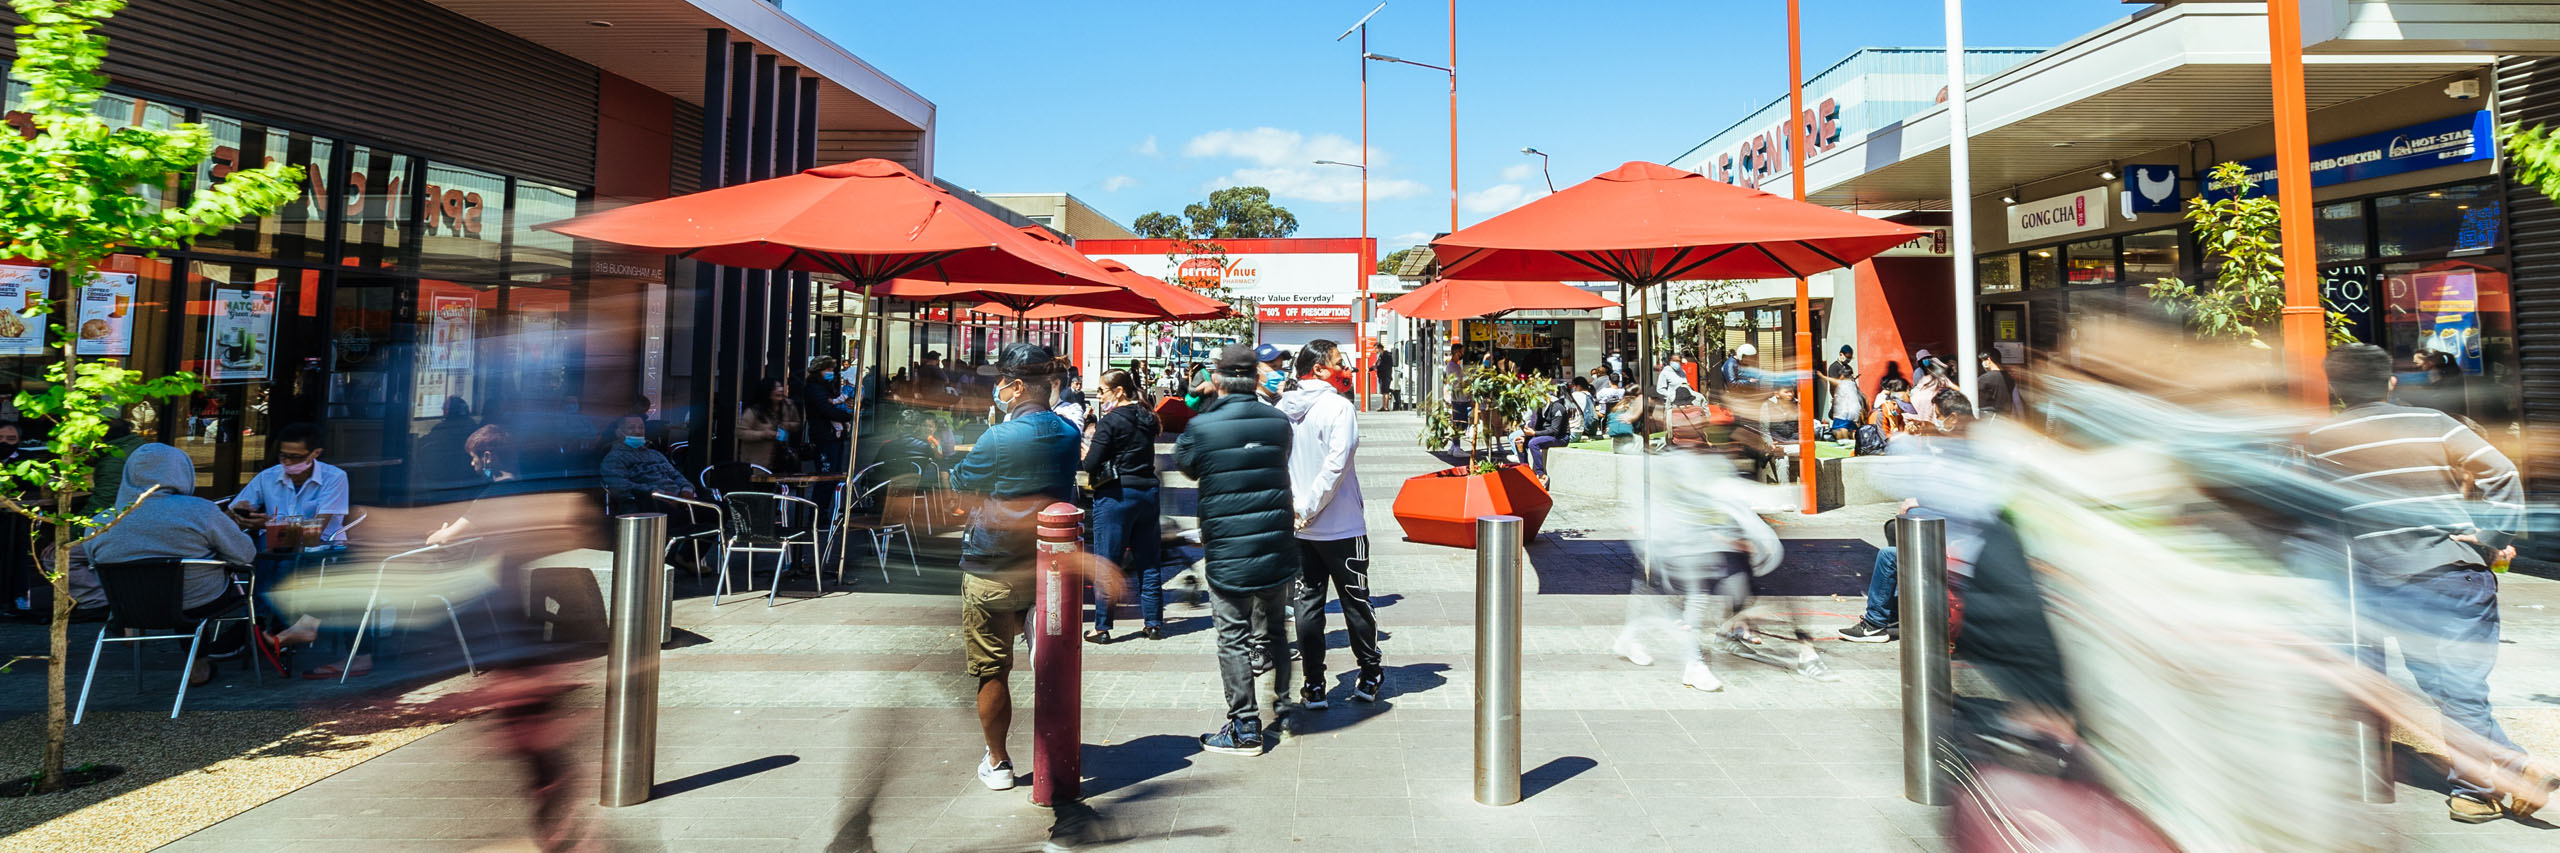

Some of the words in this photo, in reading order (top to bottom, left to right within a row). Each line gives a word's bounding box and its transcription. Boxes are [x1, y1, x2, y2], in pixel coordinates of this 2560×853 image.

[1739, 97, 1837, 189] CENTRE
[2411, 129, 2473, 148] HOT-STAR
[2309, 159, 2337, 173] FRIED
[2337, 149, 2383, 167] CHICKEN
[2021, 210, 2051, 230] GONG
[2052, 205, 2075, 224] CHA
[609, 263, 650, 278] BUCKINGHAM
[651, 268, 662, 279] AVE
[1181, 266, 1220, 278] BETTER
[1223, 258, 1256, 278] VALUE
[2326, 278, 2408, 299] FOD
[223, 301, 265, 311] MATCHA
[1267, 294, 1291, 302] Value
[1293, 294, 1335, 303] Everyday!
[1285, 307, 1299, 316] OFF
[1300, 307, 1351, 317] PRESCRIPTIONS
